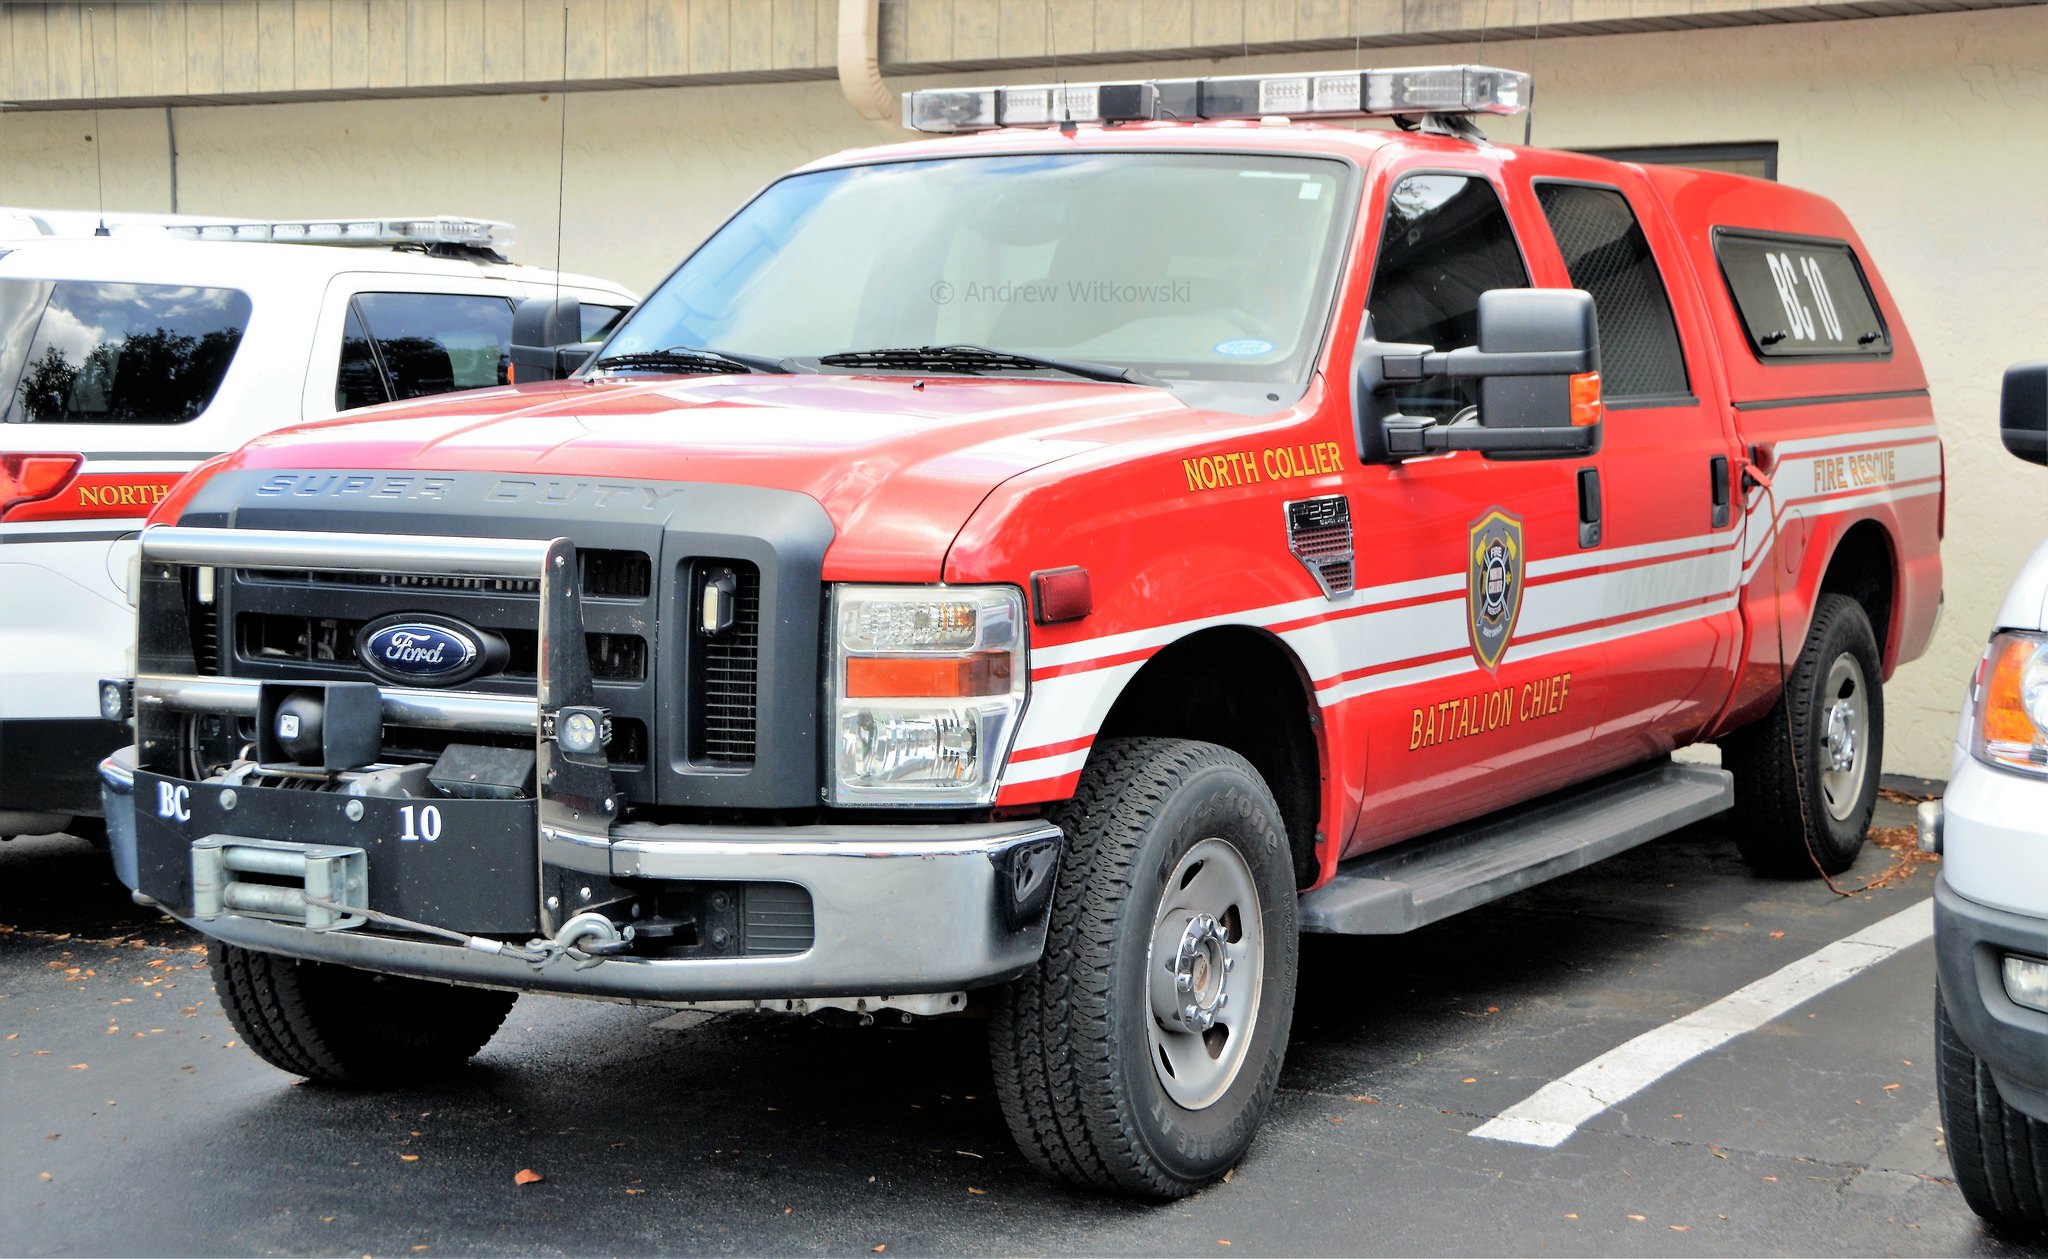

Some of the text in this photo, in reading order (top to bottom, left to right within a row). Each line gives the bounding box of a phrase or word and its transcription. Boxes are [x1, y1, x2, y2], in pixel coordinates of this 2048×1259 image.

[1765, 252, 1843, 342] BC 10
[1182, 441, 1345, 492] NORTH COLLIER
[1813, 450, 1896, 493] FIRE RESCUE
[77, 484, 169, 507] NORTH
[255, 474, 686, 510] SUPER DUTY
[385, 631, 446, 664] Ford
[1409, 672, 1572, 752] BATTALION CHIEF
[157, 780, 442, 842] BC 10
